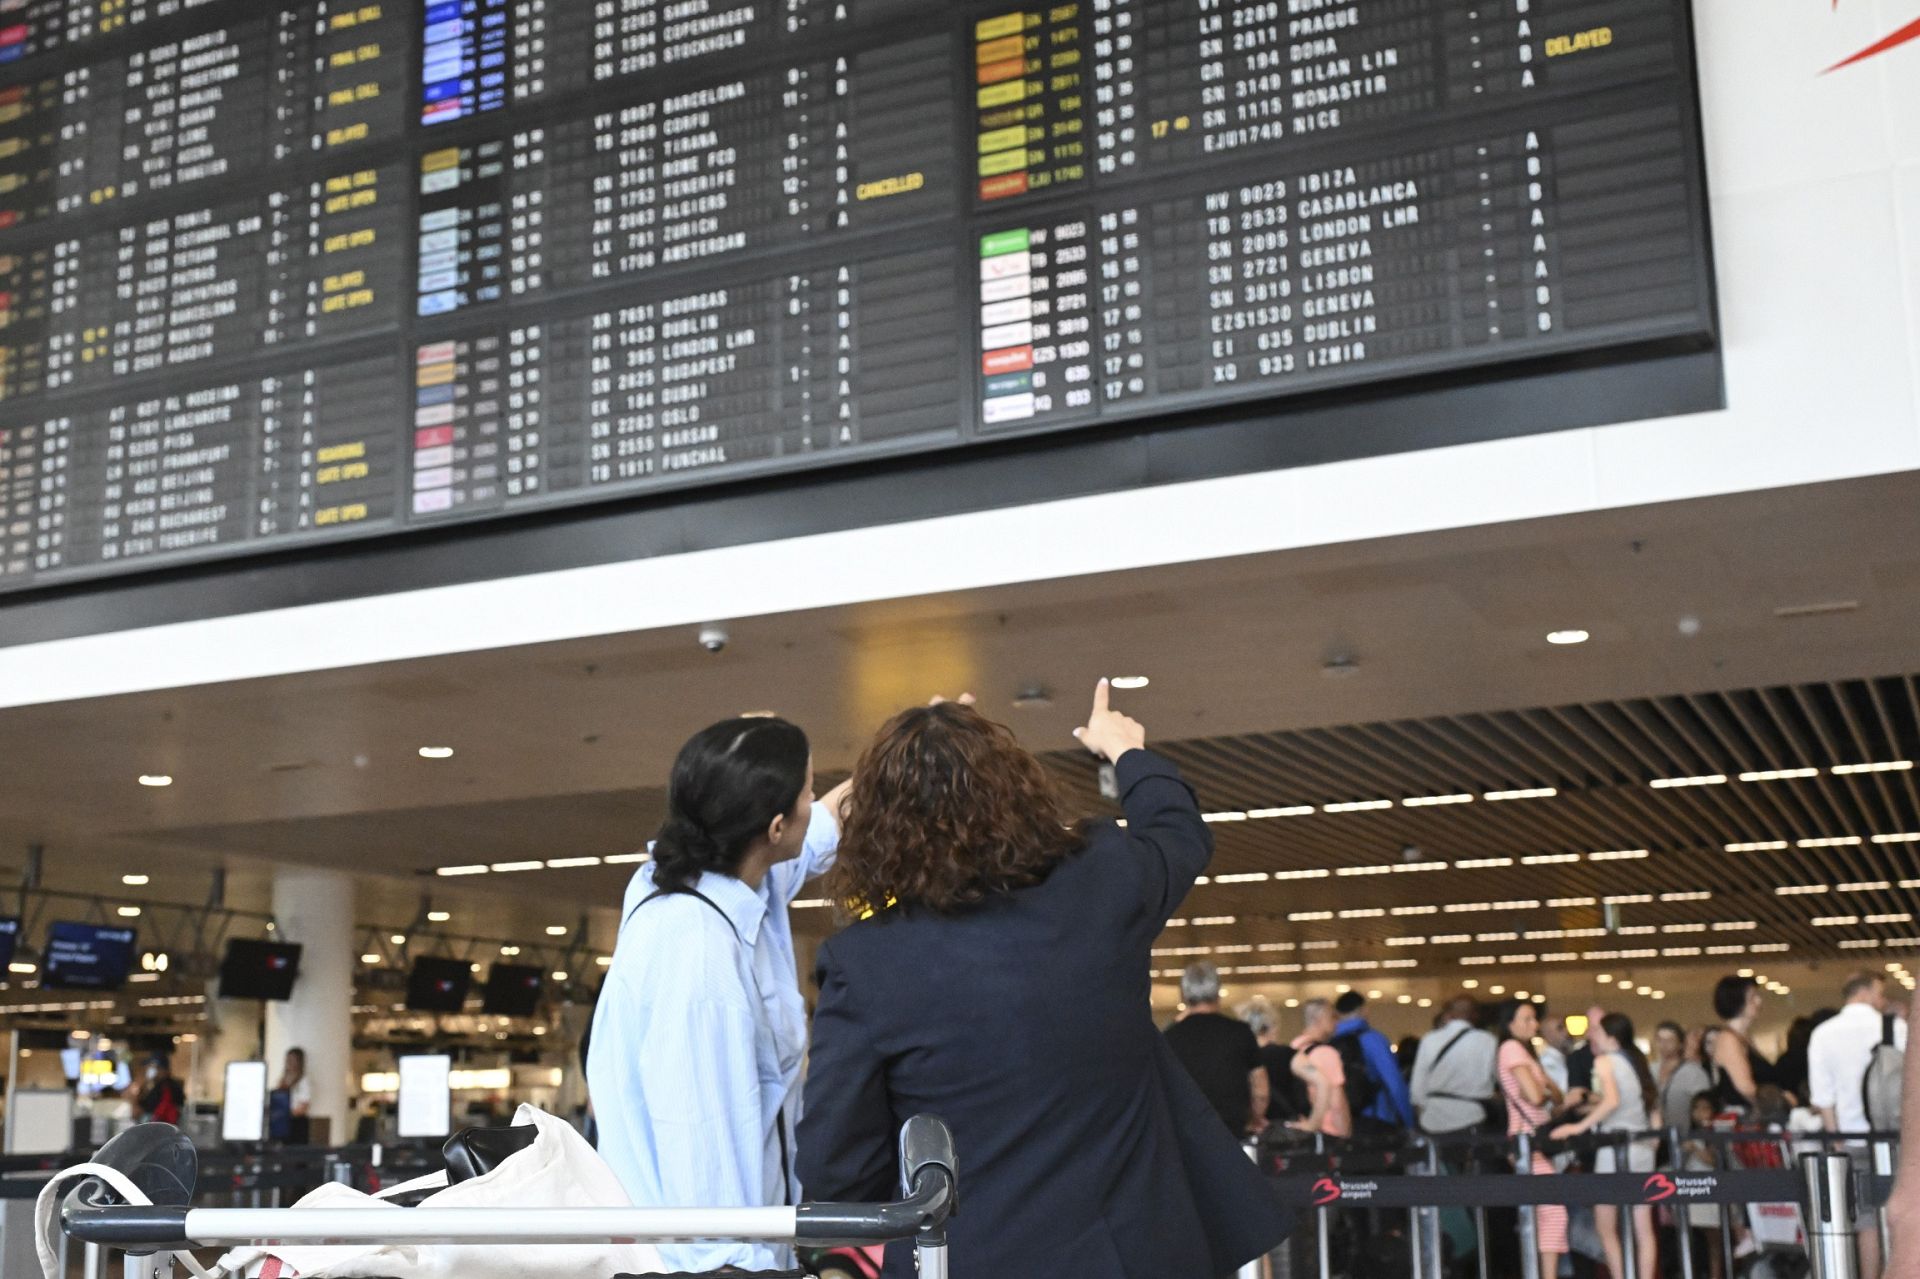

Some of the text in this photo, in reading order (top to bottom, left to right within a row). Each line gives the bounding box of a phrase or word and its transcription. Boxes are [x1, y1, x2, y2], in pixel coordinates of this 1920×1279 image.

[1290, 8, 1358, 37] PRAGUE
[1290, 38, 1336, 61] DOHA
[1291, 60, 1350, 85] MILAN
[1292, 76, 1386, 109] MONASTIR
[1293, 109, 1339, 133] NICE
[1240, 181, 1286, 205] 9023
[1299, 168, 1355, 193] IBIZA
[1298, 181, 1417, 218] CASABLANCA
[1208, 241, 1231, 260] SN
[1243, 230, 1288, 254] 2095
[1300, 215, 1370, 243] LONDON
[1209, 266, 1232, 284] SN
[1243, 256, 1287, 278] 2721
[1301, 240, 1371, 267] GENEVA
[1211, 290, 1233, 308] SN
[1246, 280, 1290, 302] 3819
[1302, 265, 1373, 292] LISBON
[1212, 305, 1291, 332] EZS1530
[1303, 290, 1374, 317] GENEVA
[1213, 339, 1233, 357] EI
[1258, 329, 1292, 350] 635
[1304, 316, 1376, 342] DUBLIN
[1260, 354, 1294, 374] 933
[1308, 342, 1364, 366] IZMIR
[1340, 1181, 1378, 1191] brussels
[1341, 1190, 1372, 1200] airport
[1675, 1176, 1718, 1187] brussels
[1676, 1186, 1711, 1198] airport
